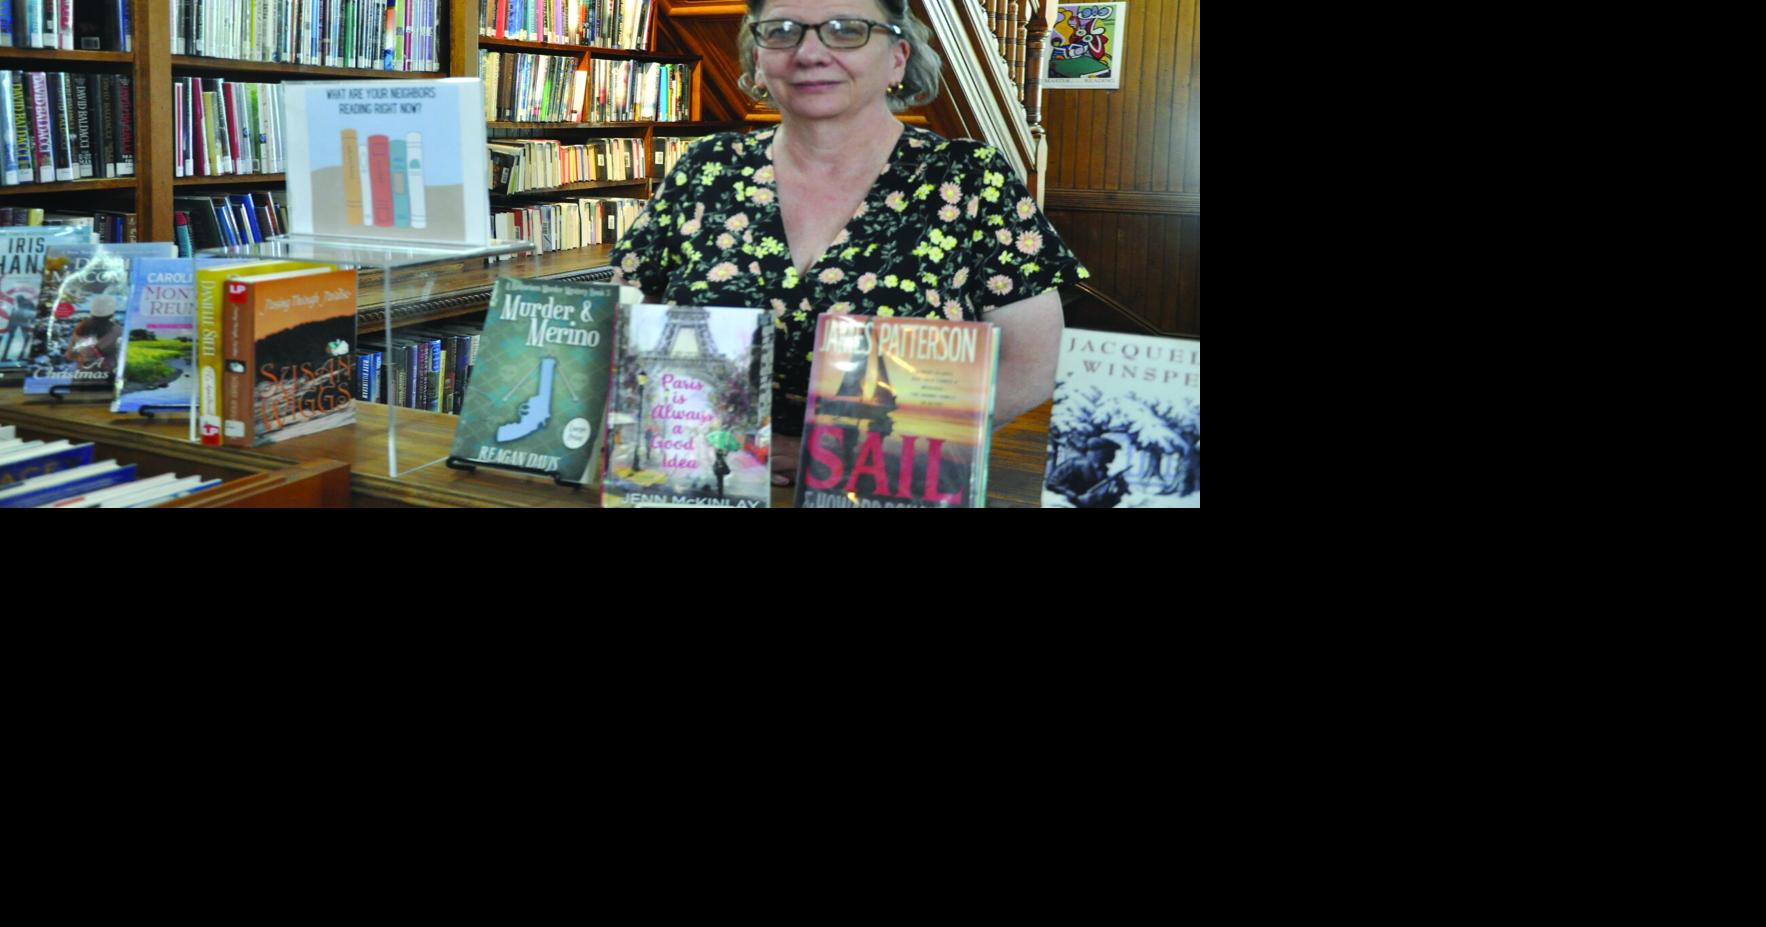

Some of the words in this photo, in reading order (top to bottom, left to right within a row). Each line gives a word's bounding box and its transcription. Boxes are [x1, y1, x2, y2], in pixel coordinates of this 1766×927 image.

[13, 83, 25, 111] DAVID
[32, 74, 46, 106] DAVID
[76, 86, 88, 110] DAVID
[327, 89, 346, 99] WHAT
[349, 88, 363, 99] ARE
[366, 87, 389, 99] YOUR
[390, 86, 436, 98] NEIGHBORS
[339, 103, 372, 114] READING
[374, 103, 398, 114] RIGHT
[400, 102, 422, 114] NOW?
[35, 106, 51, 153] BALDACCI
[78, 111, 90, 148] BALDACCI
[8, 237, 45, 253] IRIS
[147, 272, 193, 283] CAROLI
[229, 284, 246, 294] LP
[145, 286, 194, 301] MON
[201, 281, 216, 326] DANIELLE
[500, 294, 575, 321] Murder
[580, 300, 594, 322] &
[202, 330, 217, 356] STEEL
[525, 317, 600, 347] Merino
[819, 318, 874, 354] JAMES
[877, 322, 977, 363] PATTERSON
[1069, 338, 1200, 366] JACQUEL
[33, 365, 109, 379] Christmas
[260, 355, 354, 398] SUSAN
[661, 373, 704, 391] Paris
[1083, 360, 1199, 388] WINSPE
[261, 382, 353, 432] WIGGS
[672, 391, 686, 404] is
[651, 402, 714, 423] Always
[672, 424, 683, 435] a
[650, 436, 694, 450] Good
[480, 445, 527, 466] REAGAN
[525, 453, 561, 472] DAVIS
[662, 454, 699, 469] Idea
[803, 425, 964, 505] SAIL
[623, 493, 670, 504] JENN
[672, 495, 760, 508] McKINLAY
